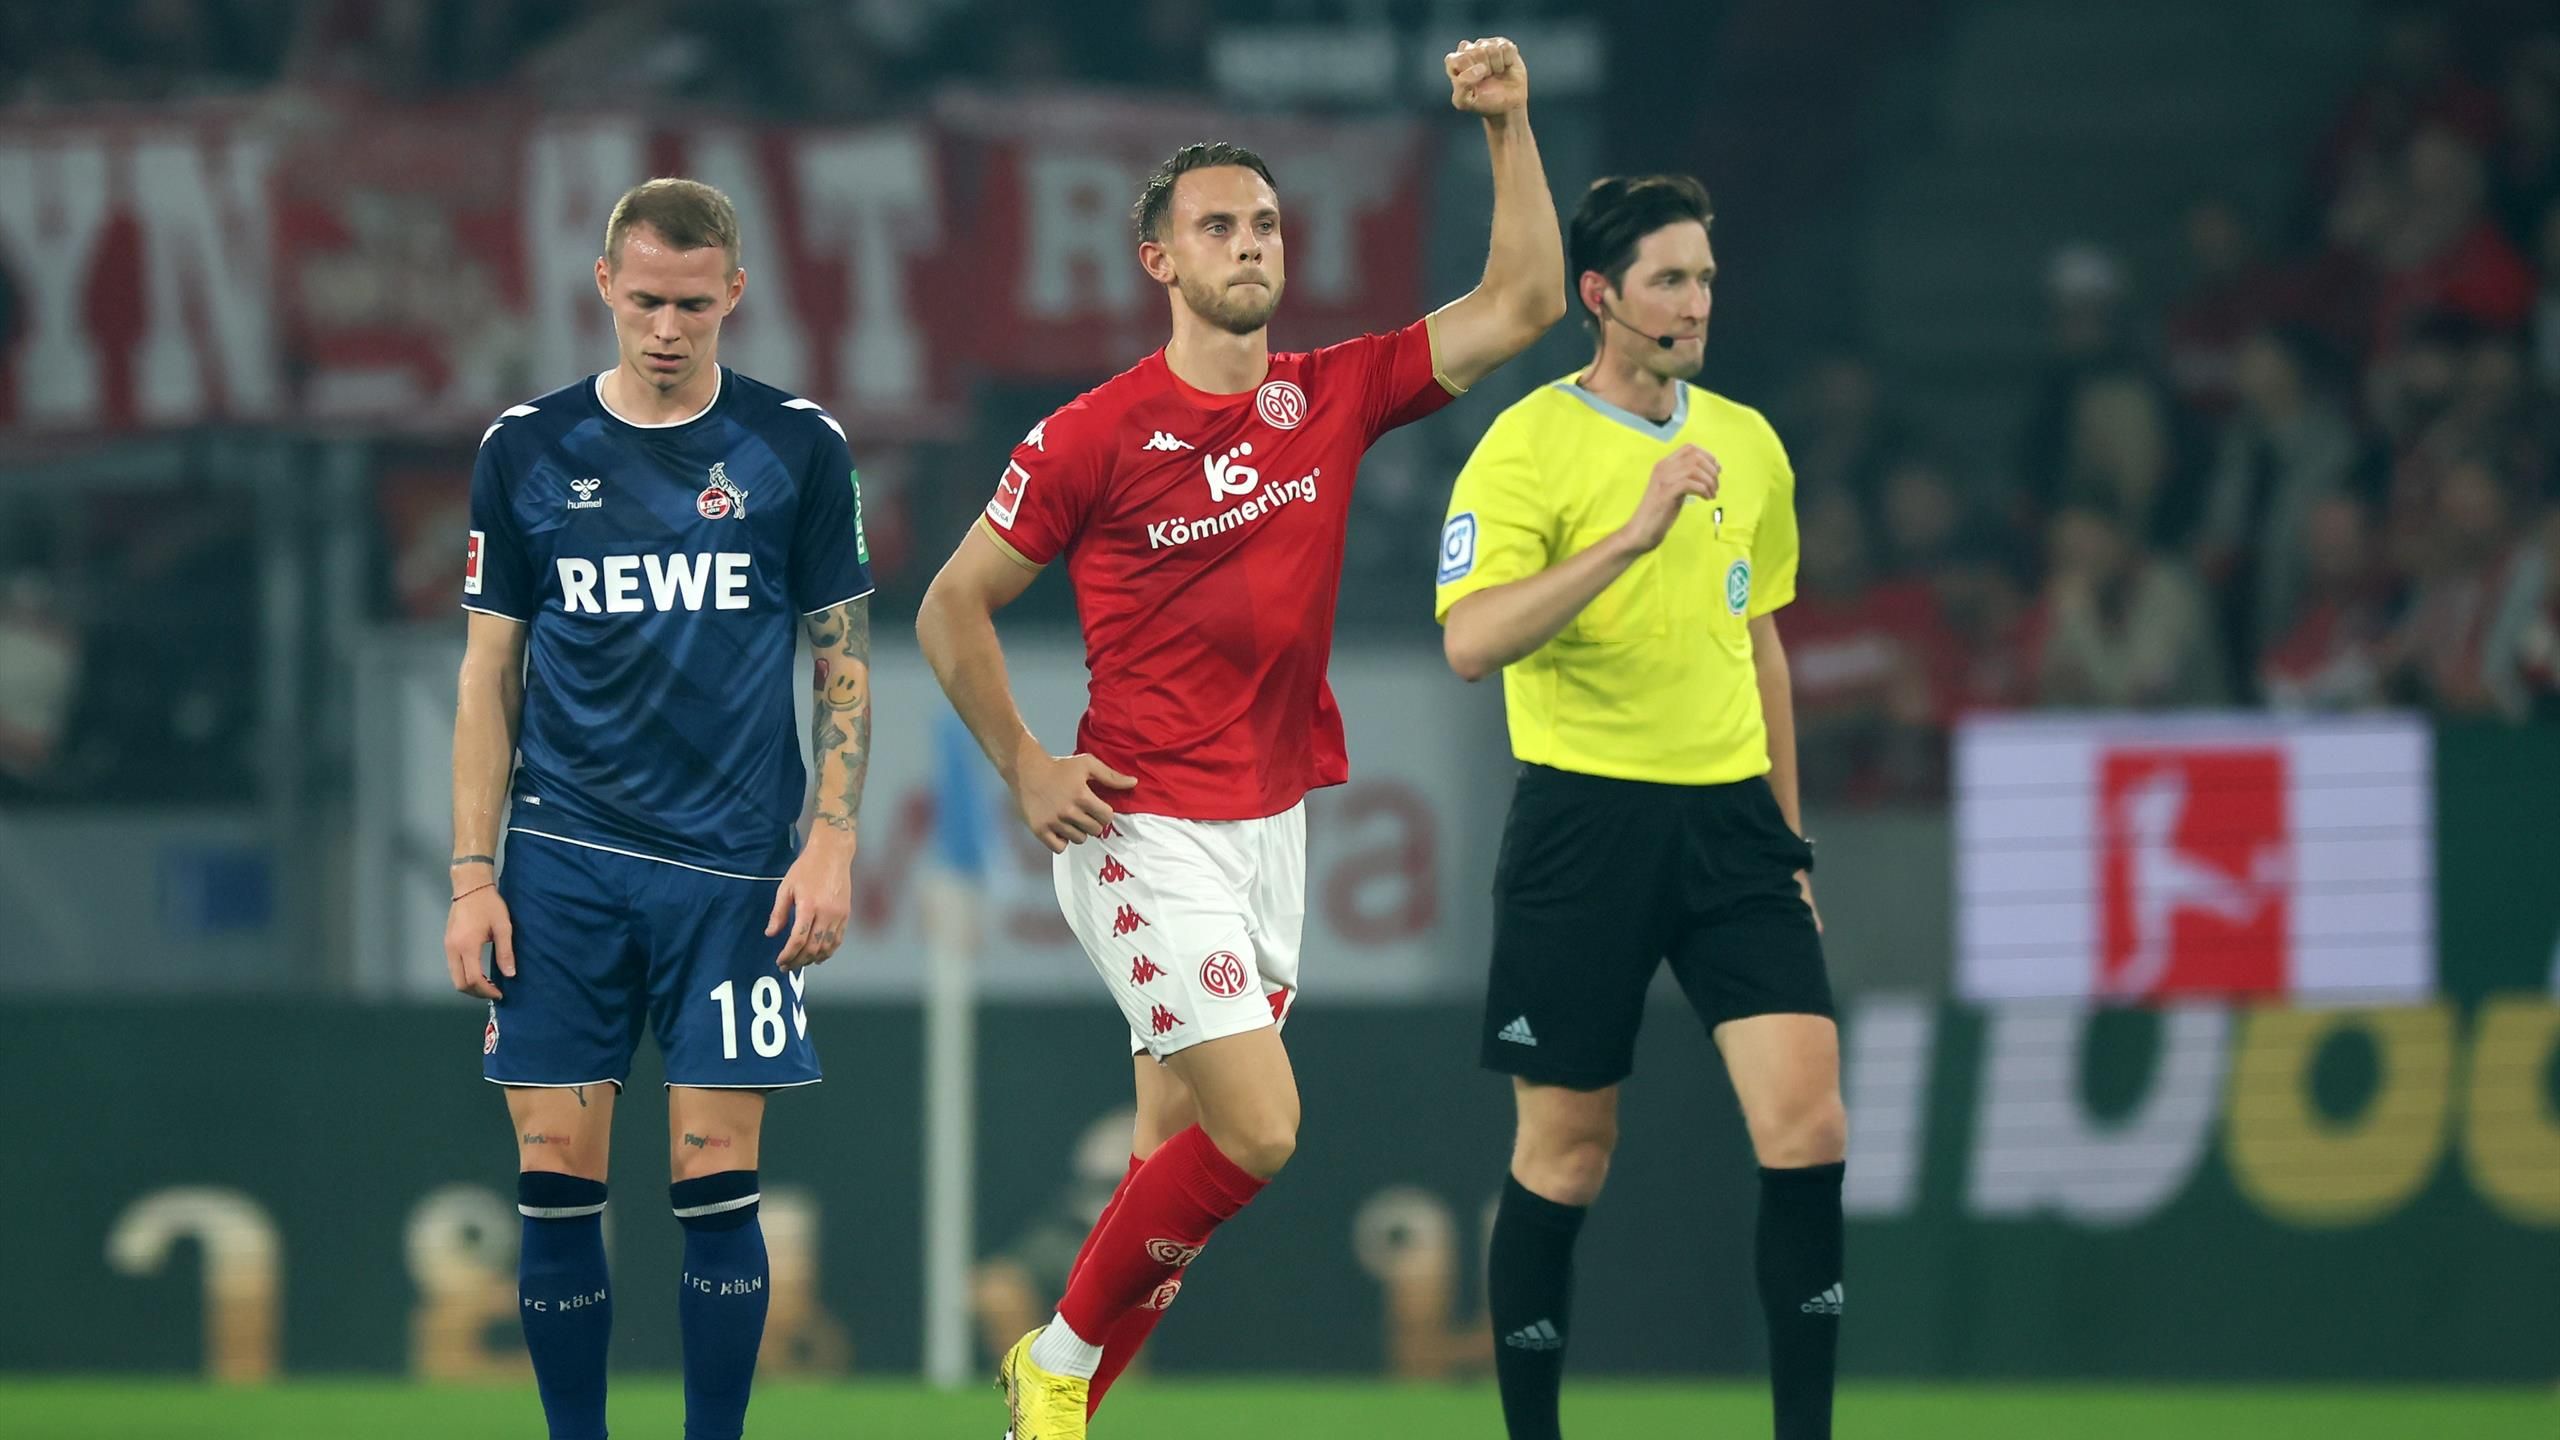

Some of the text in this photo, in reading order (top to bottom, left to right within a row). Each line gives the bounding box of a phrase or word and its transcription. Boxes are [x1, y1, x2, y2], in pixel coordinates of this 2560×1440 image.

[567, 498, 603, 510] hummel
[556, 552, 751, 614] REWE
[709, 975, 787, 1060] 18
[693, 1276, 711, 1293] FC
[720, 1275, 762, 1296] KÖLN
[524, 1288, 606, 1313] FC KÖLN
